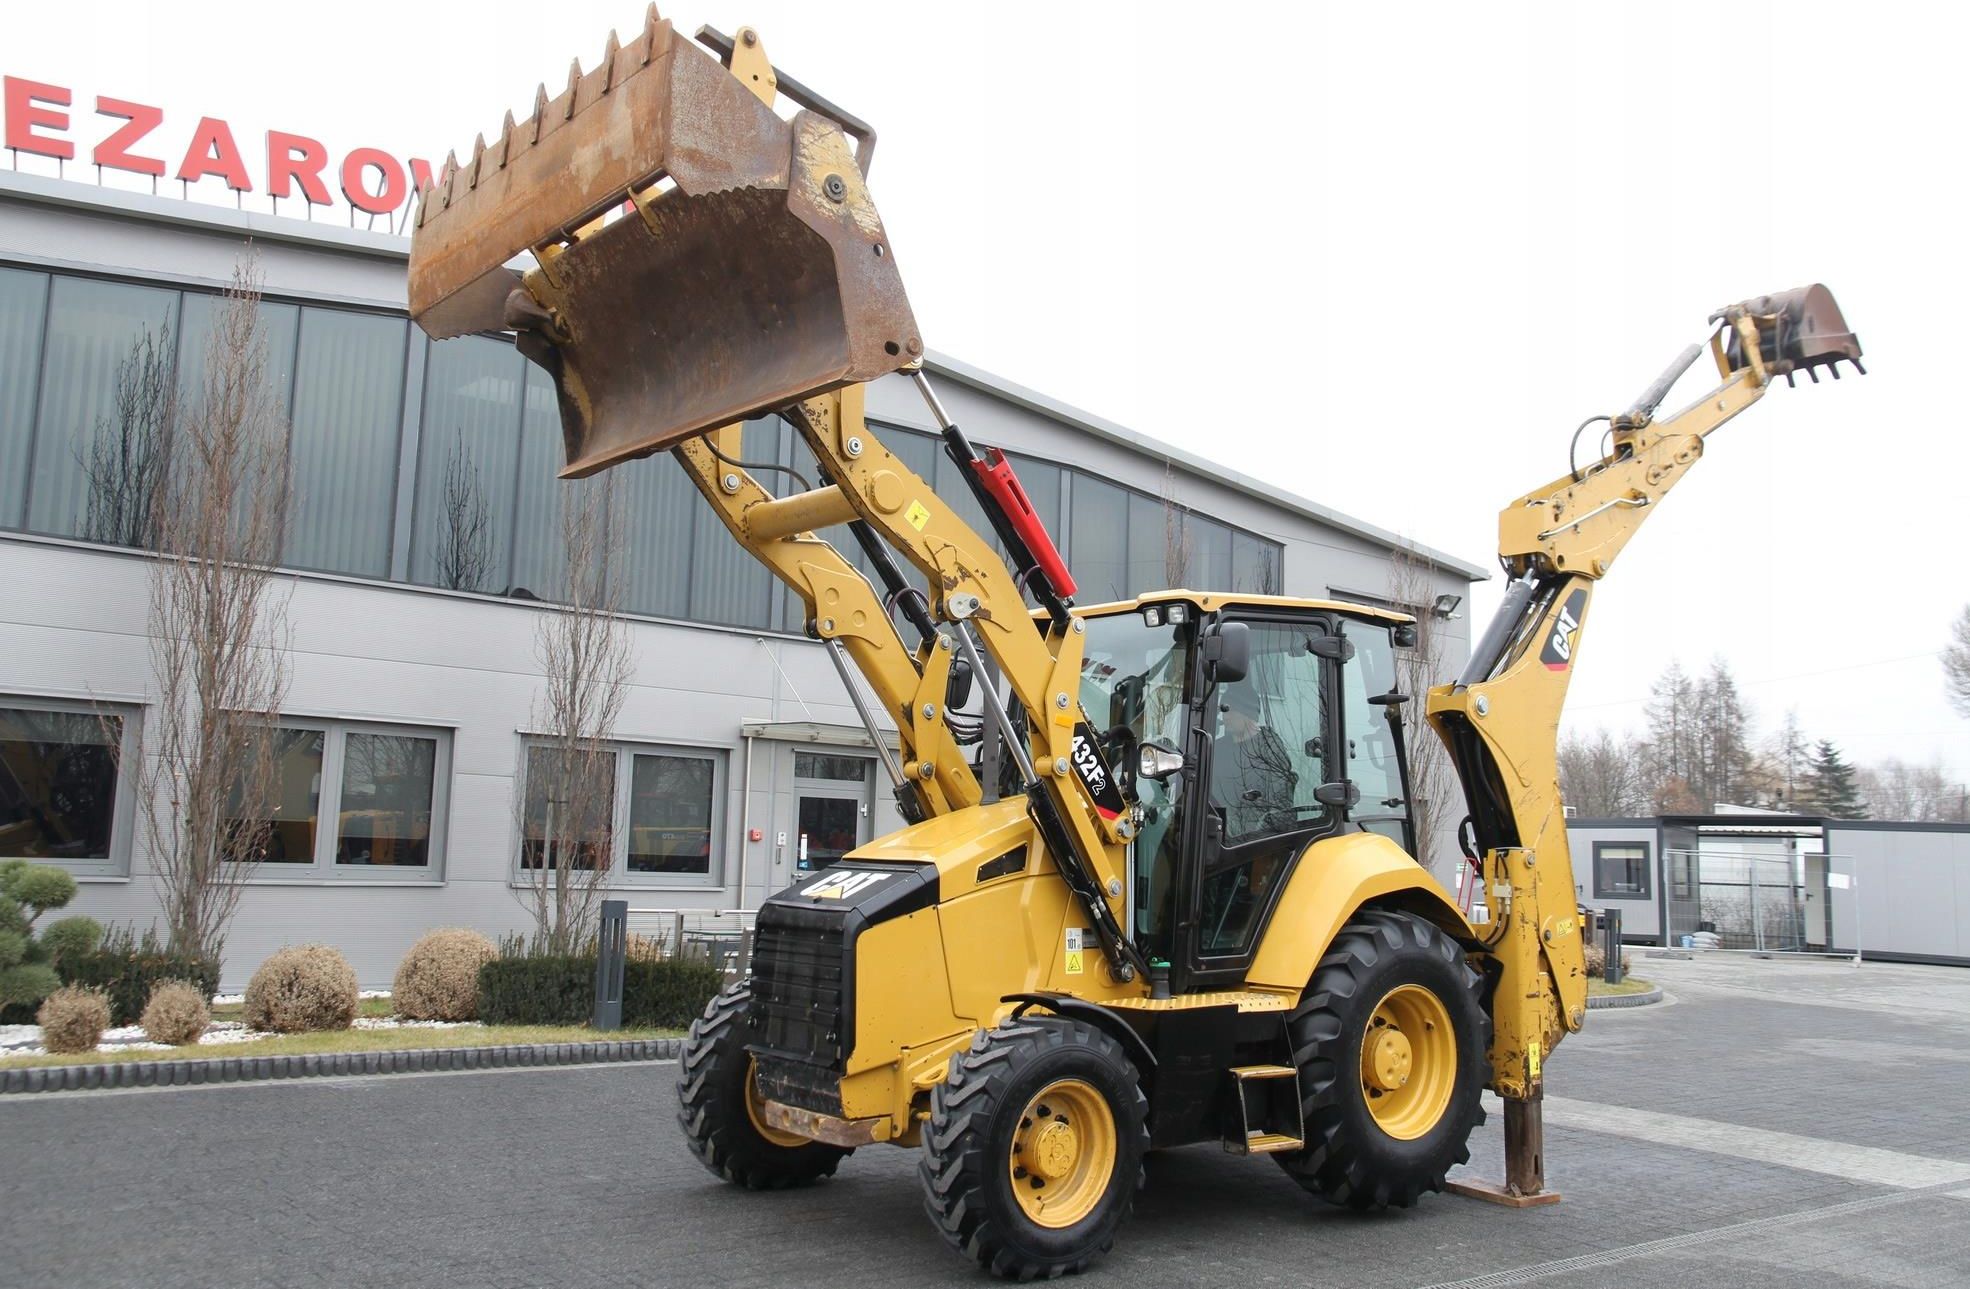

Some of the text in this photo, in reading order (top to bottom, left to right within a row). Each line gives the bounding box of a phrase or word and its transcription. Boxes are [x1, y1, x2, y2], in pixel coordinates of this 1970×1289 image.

[1552, 605, 1578, 660] CAT
[800, 871, 893, 899] CAT
[1067, 938, 1076, 949] 101
